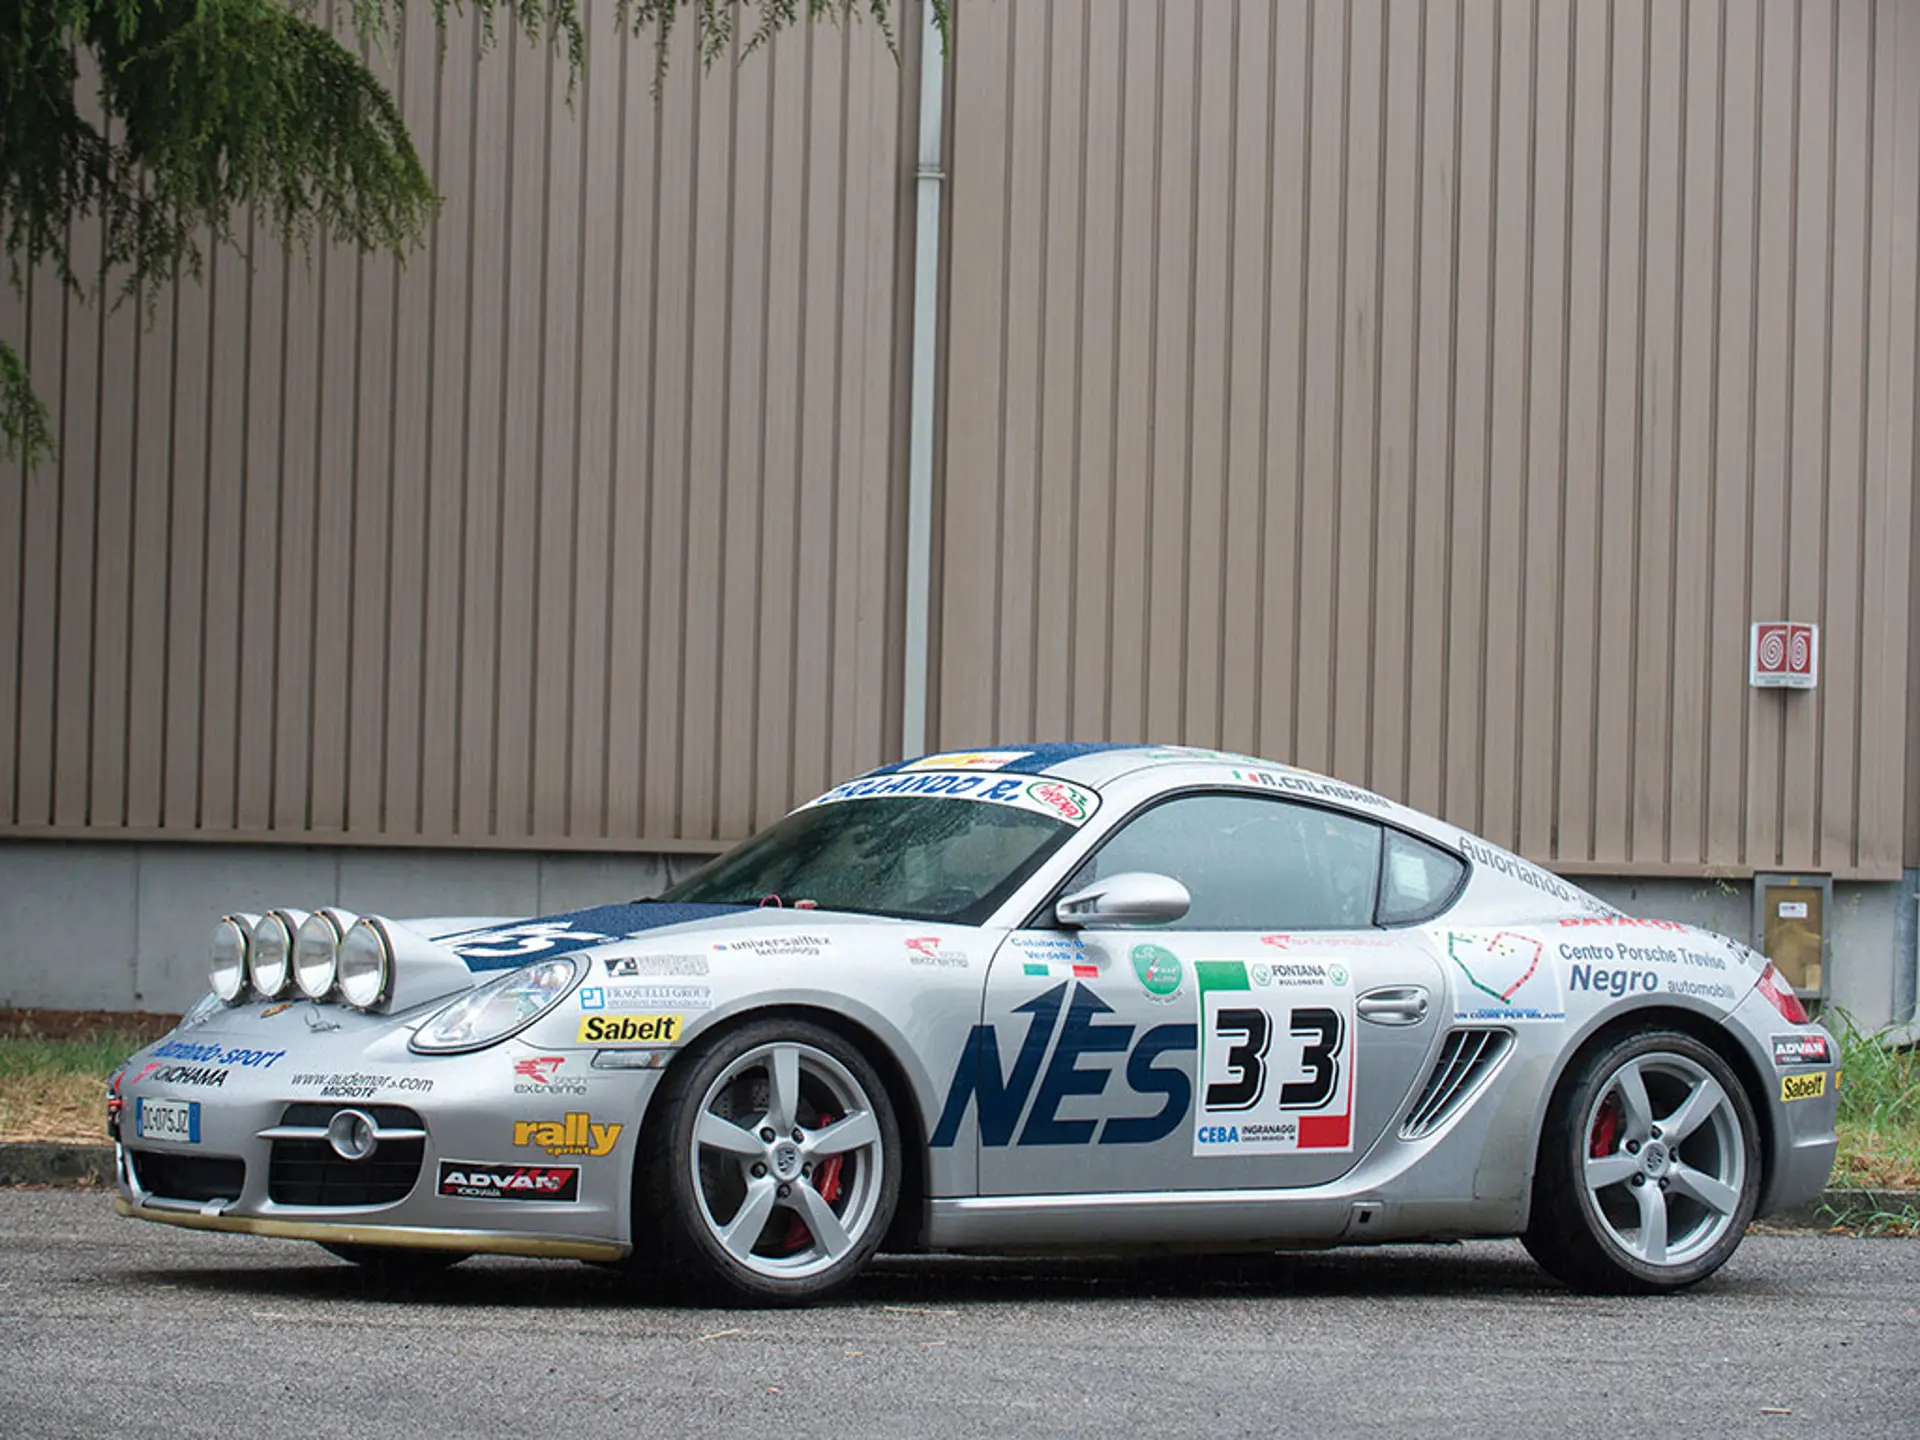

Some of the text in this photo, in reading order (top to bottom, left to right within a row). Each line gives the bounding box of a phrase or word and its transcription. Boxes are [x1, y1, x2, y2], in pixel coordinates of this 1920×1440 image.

[1559, 943, 1614, 961] Centro
[1616, 943, 1677, 963] Porsche
[1679, 948, 1727, 971] Treviso
[1271, 964, 1326, 977] FONTANA
[1569, 964, 1659, 998] Negro
[585, 1016, 675, 1041] Sabelt
[1204, 1007, 1346, 1112] 33
[1776, 1042, 1825, 1054] ADVAN
[514, 1082, 587, 1096] extreme
[928, 1008, 1198, 1148] NES
[1784, 1075, 1823, 1099] Sabelt
[512, 1111, 624, 1158] rally
[1198, 1124, 1296, 1143] CEBA INGRANAGGI
[546, 1146, 592, 1158] sprint
[443, 1171, 561, 1190] ADVAN
